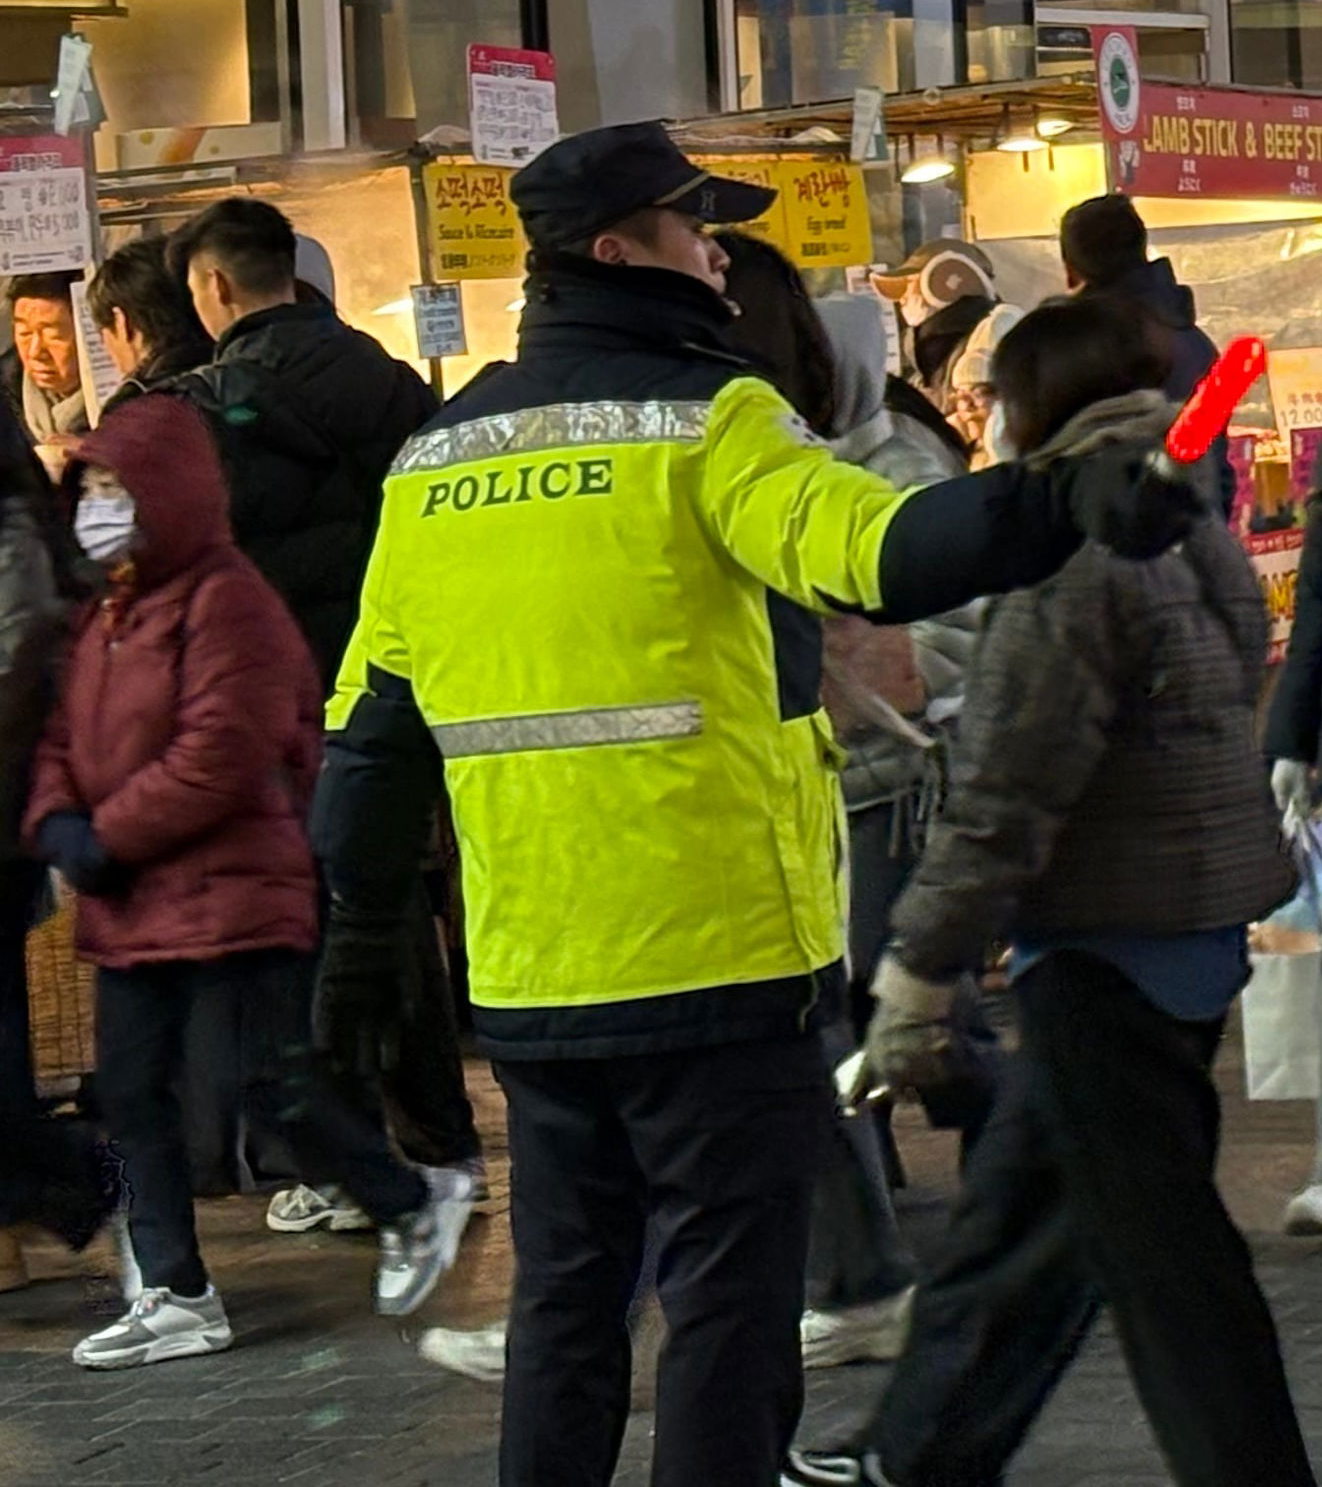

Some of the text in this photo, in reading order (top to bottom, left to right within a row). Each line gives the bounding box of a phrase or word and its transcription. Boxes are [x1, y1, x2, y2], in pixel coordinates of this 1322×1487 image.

[1143, 115, 1190, 154] LAMB
[1193, 118, 1239, 157] STICK
[1245, 121, 1258, 158] &
[1264, 123, 1303, 160] BEEF
[435, 173, 506, 217] 소떡소떡
[420, 459, 613, 519] POLICE
